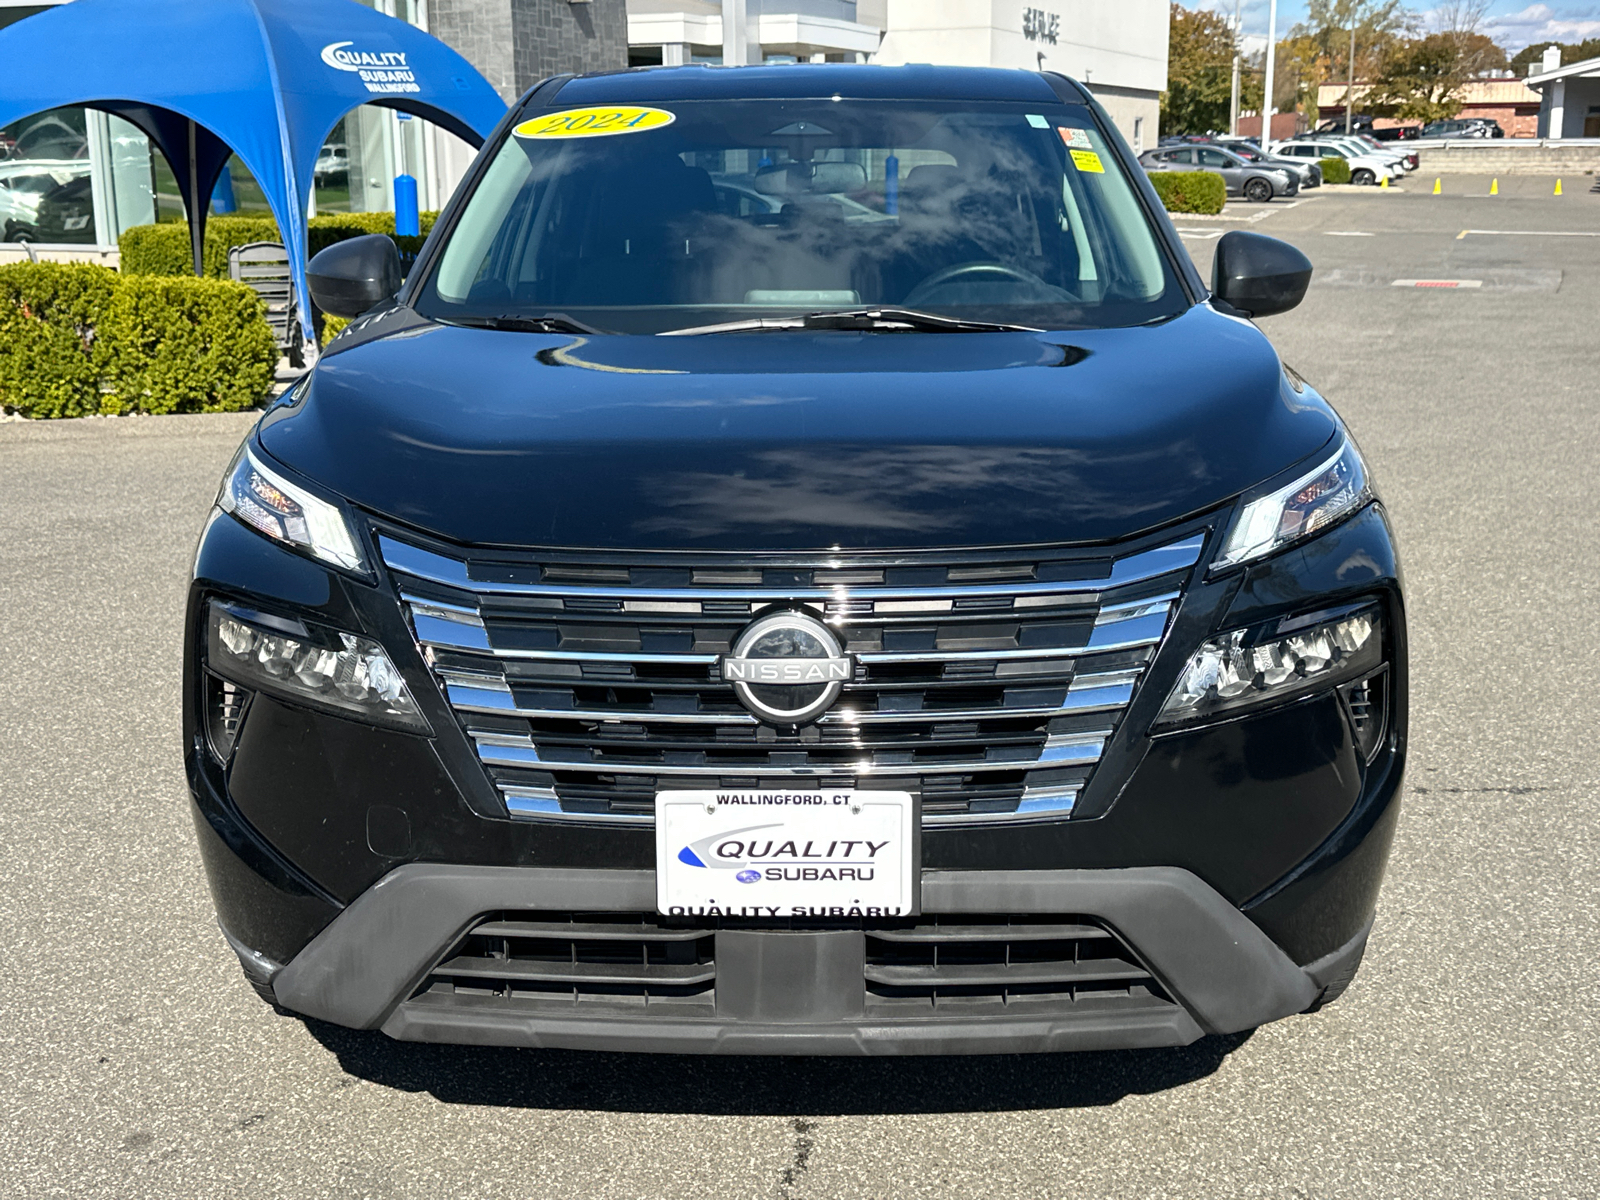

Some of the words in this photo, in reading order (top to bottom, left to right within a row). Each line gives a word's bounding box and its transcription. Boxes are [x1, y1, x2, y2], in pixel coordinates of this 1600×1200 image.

[334, 50, 406, 66] QUALITY
[358, 70, 415, 82] SUBARU
[536, 112, 651, 135] 2024
[726, 662, 849, 679] NISSAN
[716, 794, 827, 806] WALLINGFORD,
[832, 795, 851, 805] CT
[716, 840, 890, 859] QUALITY
[765, 868, 875, 882] SUBARU
[668, 906, 780, 917] QUALITY
[791, 906, 901, 917] SUBARU
